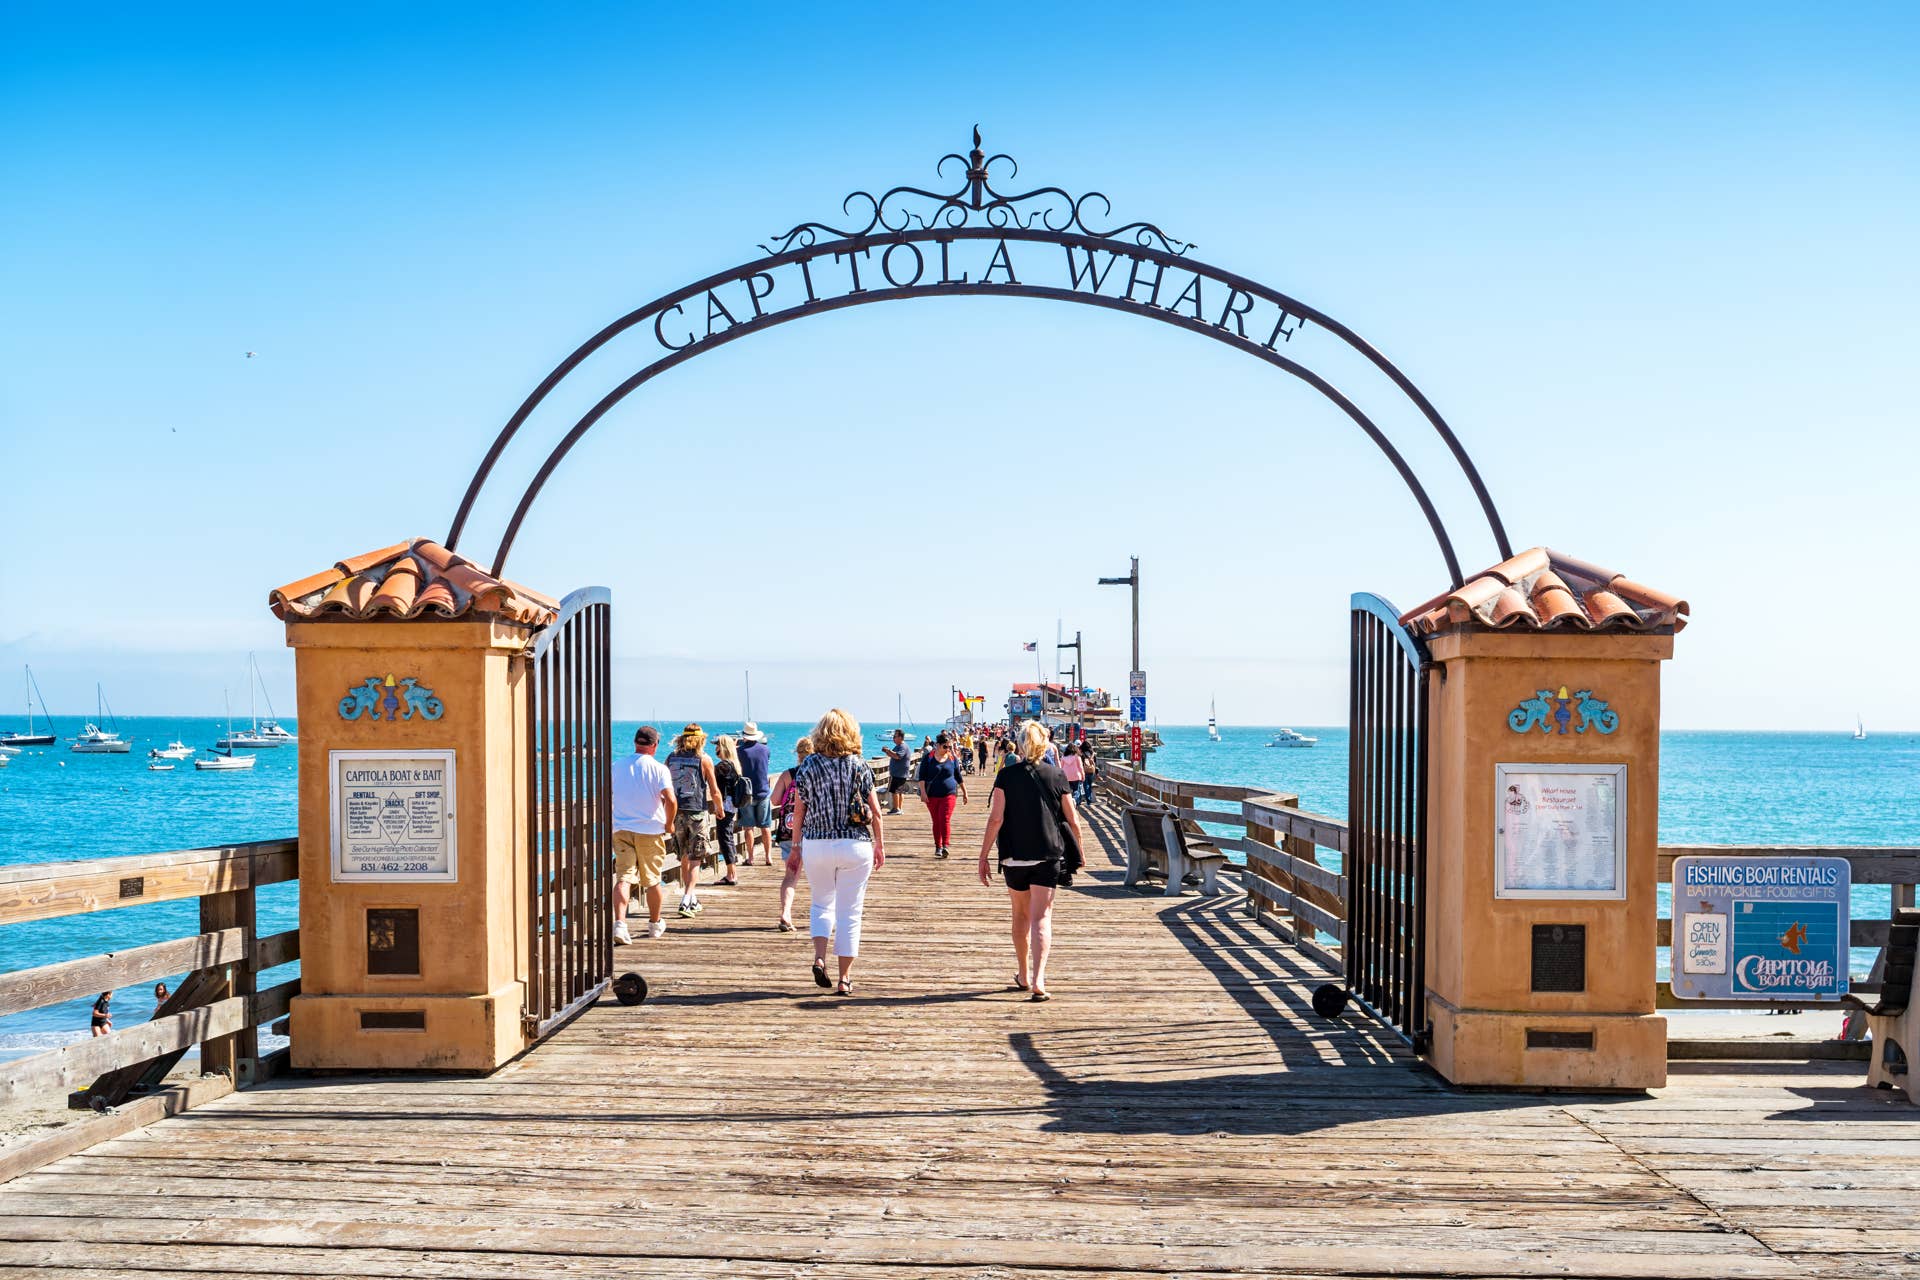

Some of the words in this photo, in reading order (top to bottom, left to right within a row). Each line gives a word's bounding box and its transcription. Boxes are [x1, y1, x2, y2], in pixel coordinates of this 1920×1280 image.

[654, 239, 1022, 351] CAPITOLA
[1060, 244, 1306, 352] WHARF
[346, 770, 388, 781] CAPITOLA
[390, 770, 411, 781] BOAT
[413, 770, 421, 781] &
[423, 770, 442, 781] BAIT
[353, 791, 375, 799] RENTALS
[385, 799, 404, 808] SNACKS
[361, 862, 428, 871] 831/462-2208
[1686, 865, 1743, 885] FISHING
[1744, 866, 1778, 886] BOAT
[1780, 866, 1838, 886] RENTALS
[1687, 886, 1713, 897] BAIT
[1720, 886, 1760, 898] TACKLE
[1767, 886, 1798, 898] FOOD
[1802, 887, 1836, 898] GIFTS
[1692, 922, 1720, 933] OPEN
[1690, 932, 1721, 943] DAILY
[1759, 974, 1793, 987] BOAT
[1794, 974, 1805, 987] &
[1806, 974, 1835, 989] BAIT
